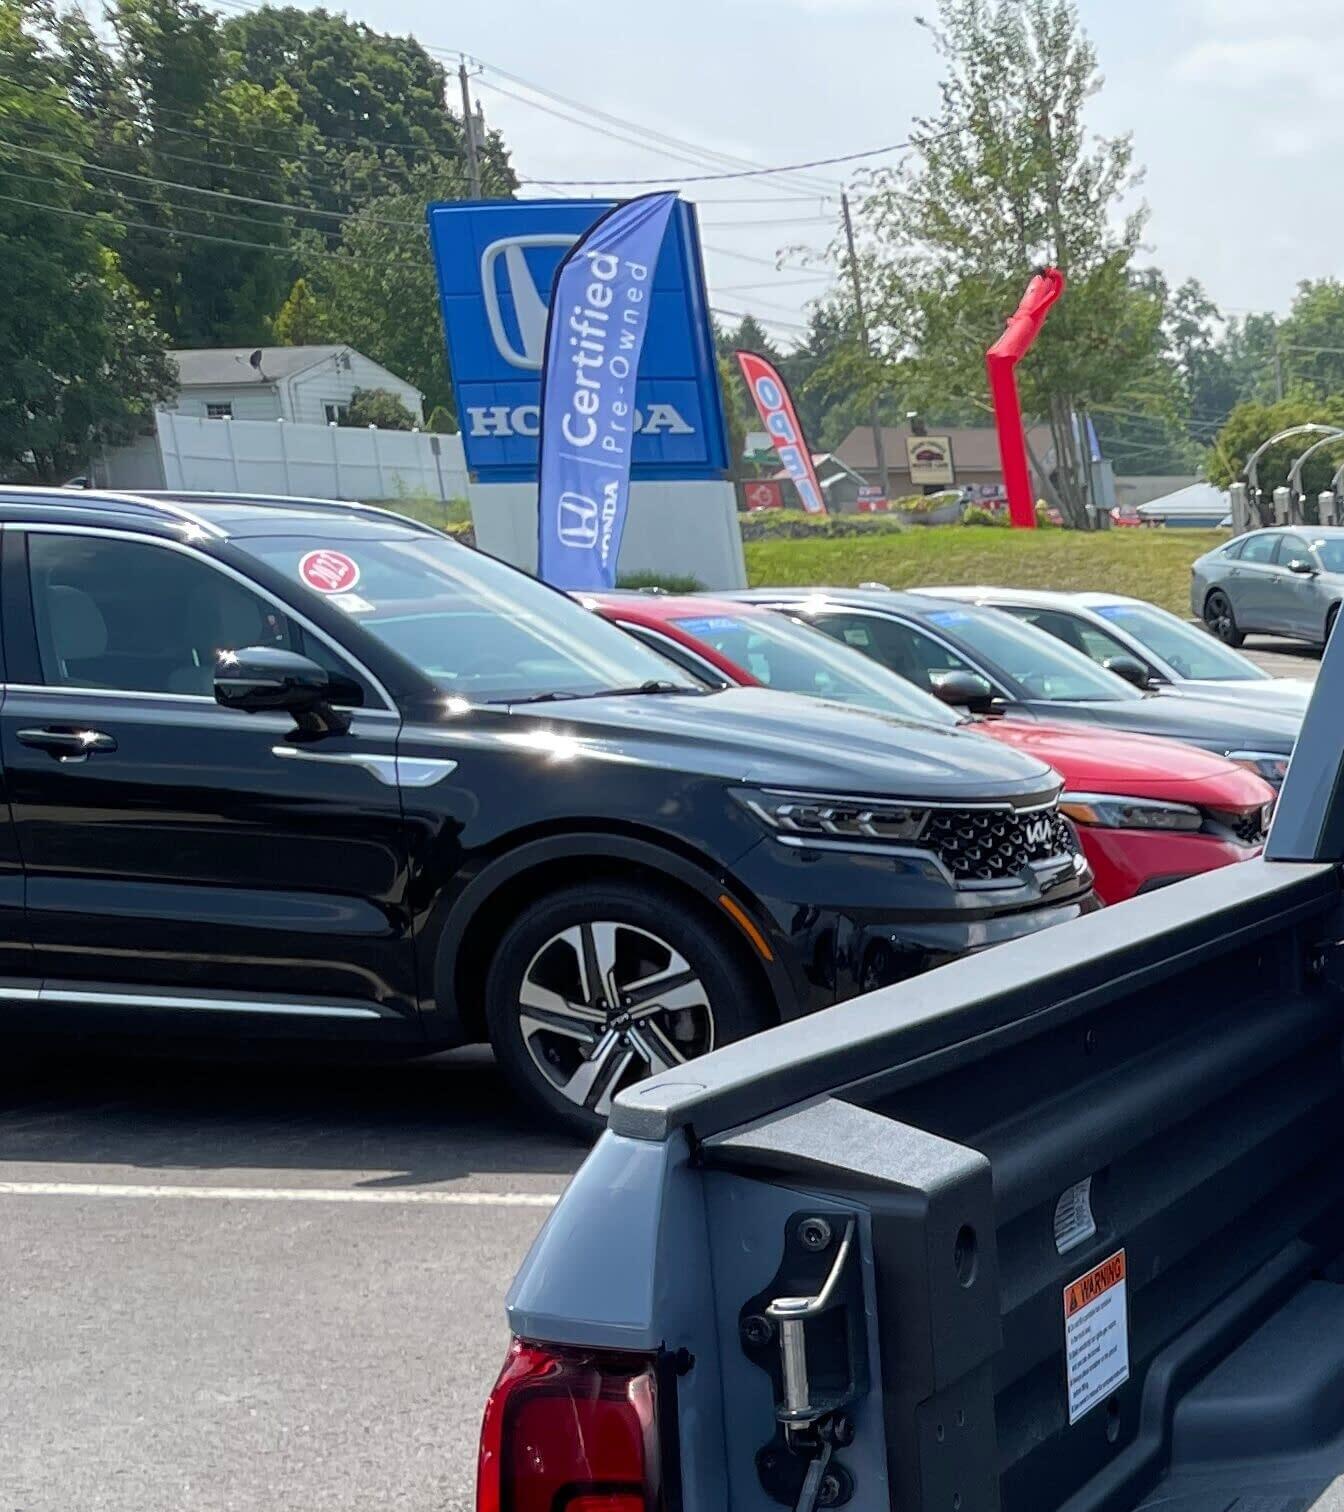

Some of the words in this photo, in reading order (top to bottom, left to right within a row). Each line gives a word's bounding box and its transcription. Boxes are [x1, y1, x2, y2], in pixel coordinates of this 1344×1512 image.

[562, 251, 620, 447] Certified
[602, 262, 647, 453] Pre-Owned
[467, 404, 694, 438] HOA
[1081, 1257, 1121, 1302] WARNING
